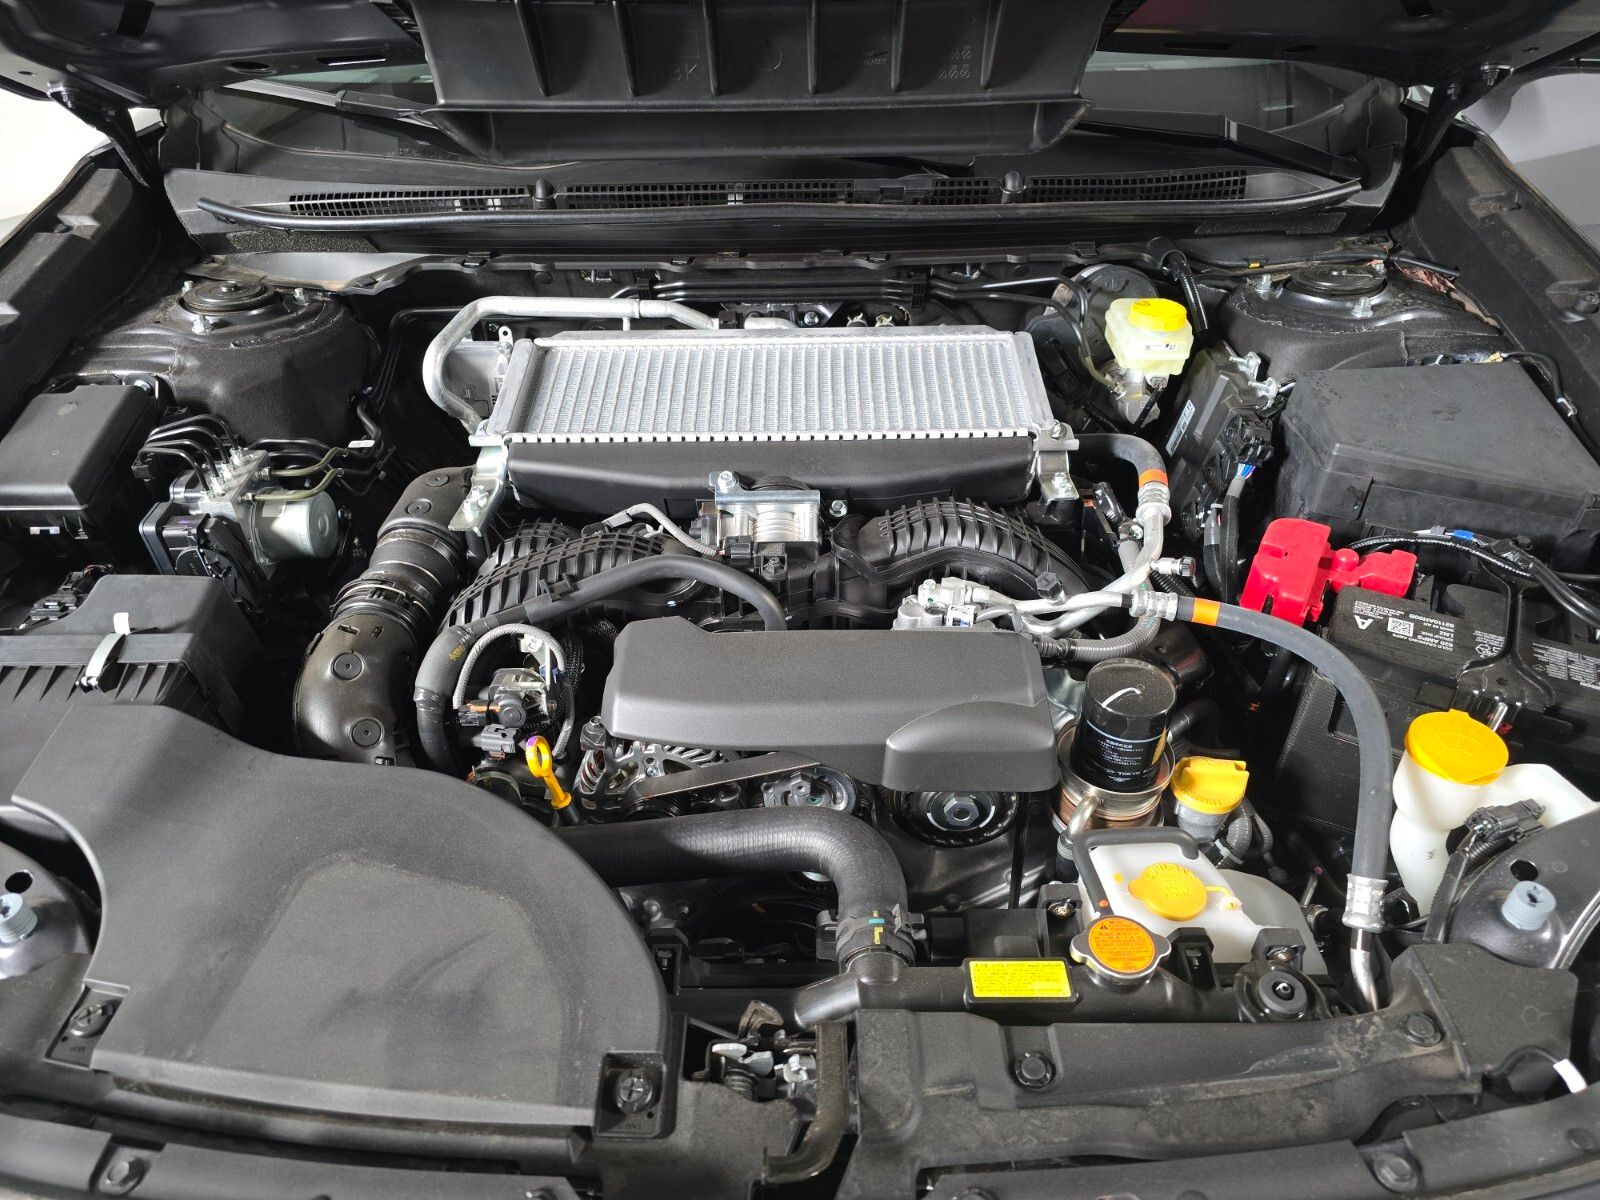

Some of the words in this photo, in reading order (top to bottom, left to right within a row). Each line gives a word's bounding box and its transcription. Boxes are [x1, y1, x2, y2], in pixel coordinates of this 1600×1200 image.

[1354, 615, 1374, 630] A
[1408, 637, 1437, 648] CRANKING
[1417, 634, 1440, 644] AMPS
[1437, 644, 1453, 652] COLD
